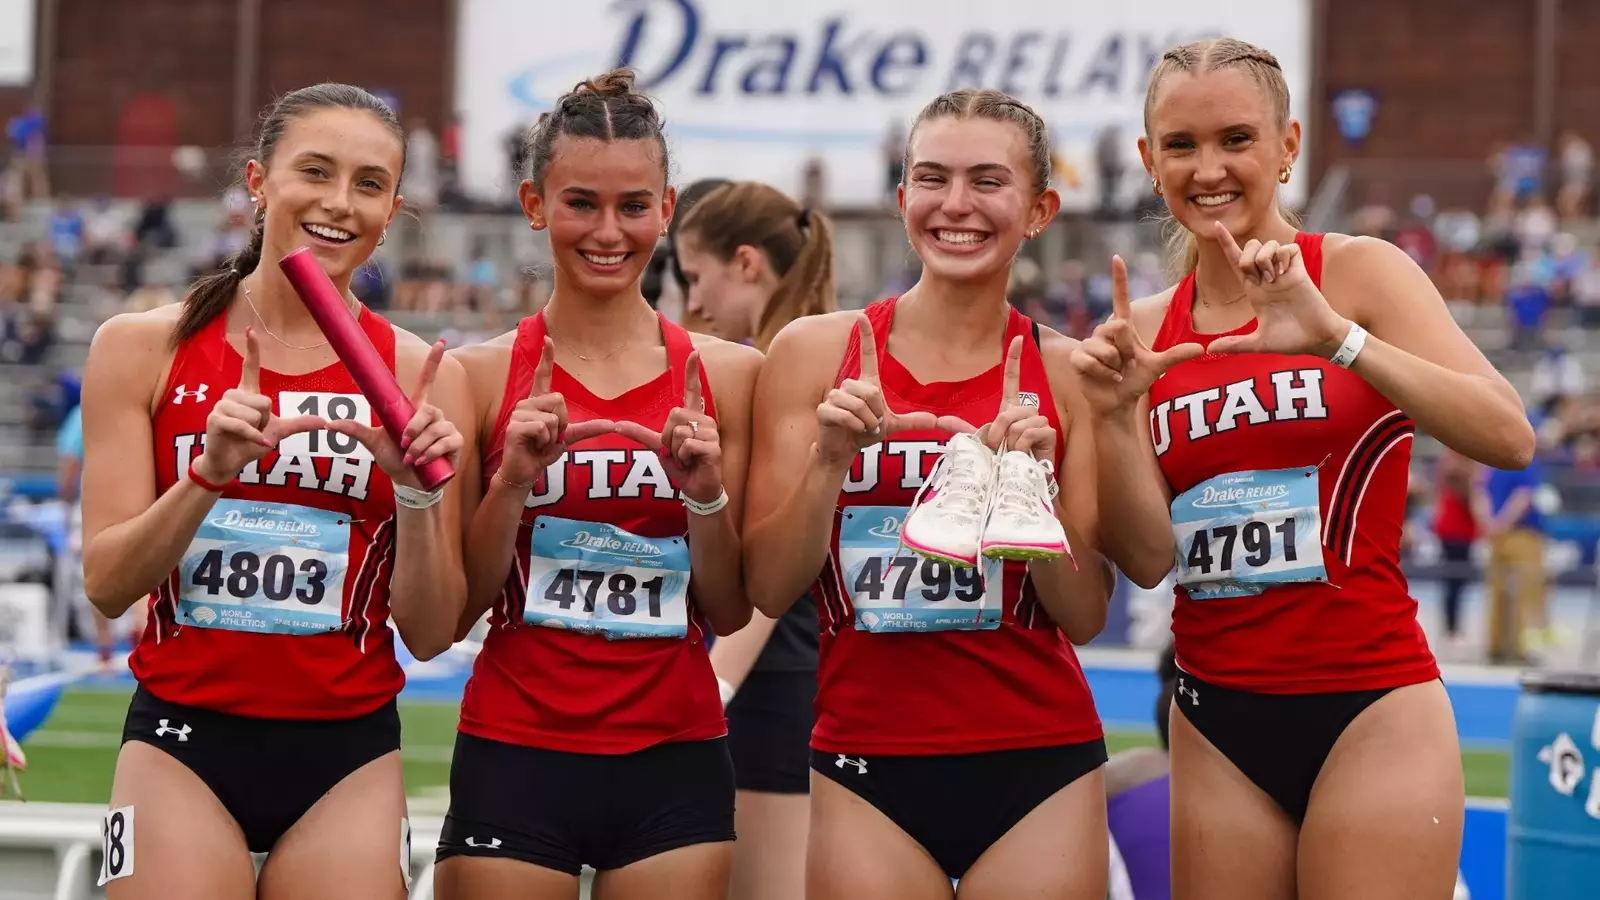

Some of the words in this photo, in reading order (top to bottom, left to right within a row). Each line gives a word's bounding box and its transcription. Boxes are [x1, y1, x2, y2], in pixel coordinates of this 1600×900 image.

[606, 0, 928, 94] Drake
[944, 28, 1228, 97] RELAY
[297, 395, 357, 455] 18
[1150, 368, 1328, 457] UTAH
[525, 449, 688, 508] UTA
[1202, 485, 1245, 504] Drake
[1246, 484, 1286, 498] RELAYS
[223, 509, 275, 530] Drake
[276, 521, 317, 534] RELAYS
[573, 530, 621, 549] Drake
[622, 541, 661, 555] RELAYS
[1187, 517, 1298, 575] 4791
[192, 548, 328, 606] 4803
[544, 568, 664, 618] 4781
[854, 556, 984, 603] 4799
[220, 609, 252, 618] WORLD
[220, 617, 266, 628] ATHLETICS
[882, 620, 927, 628] ATHLETICS
[104, 811, 125, 878] 18
